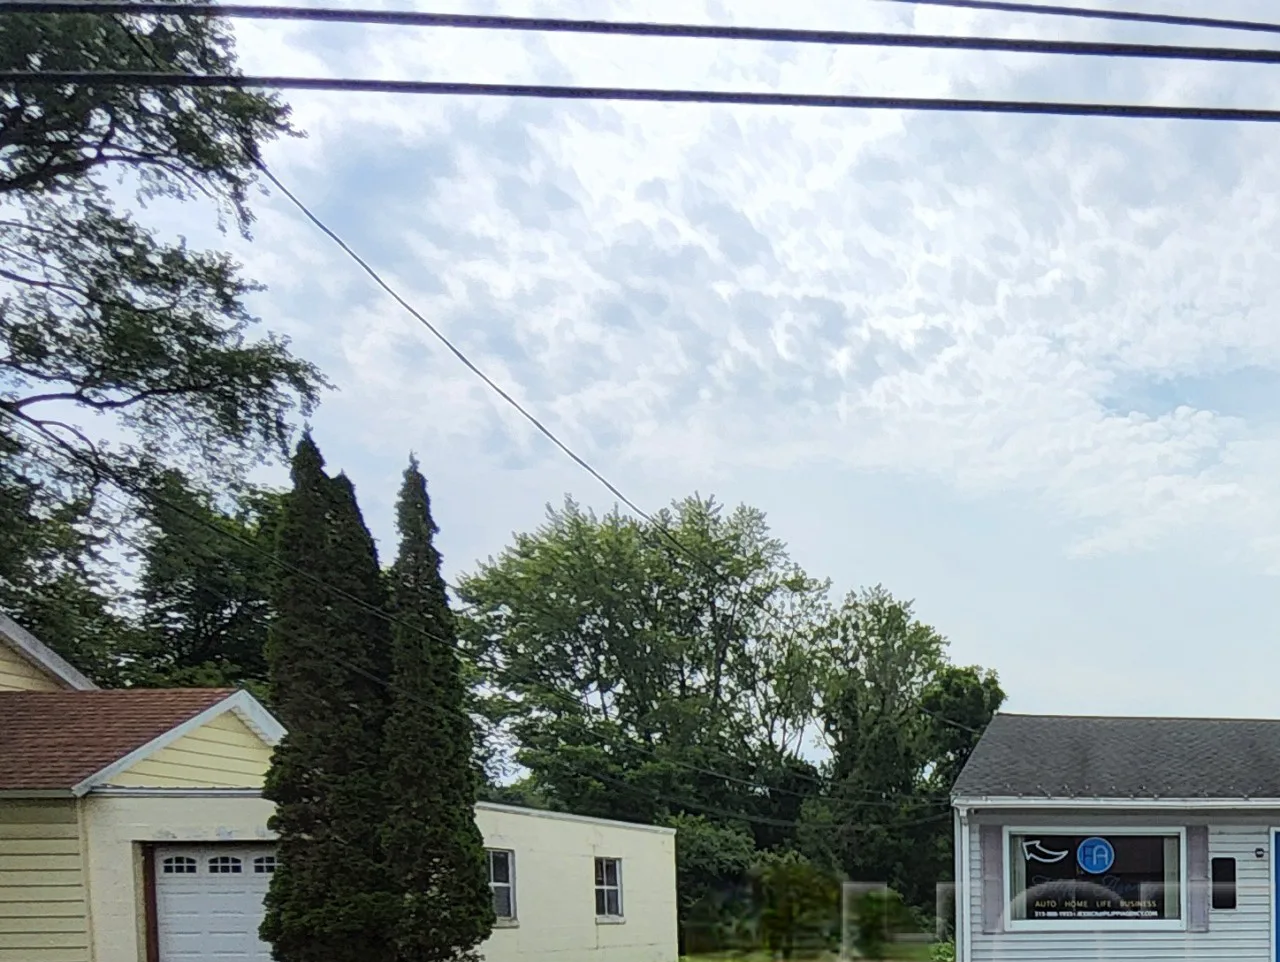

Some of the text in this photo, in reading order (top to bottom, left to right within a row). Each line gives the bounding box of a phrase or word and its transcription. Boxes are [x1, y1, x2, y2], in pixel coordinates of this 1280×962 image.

[1034, 900, 1157, 908] AUTO HOME LIFE BUSINESS
